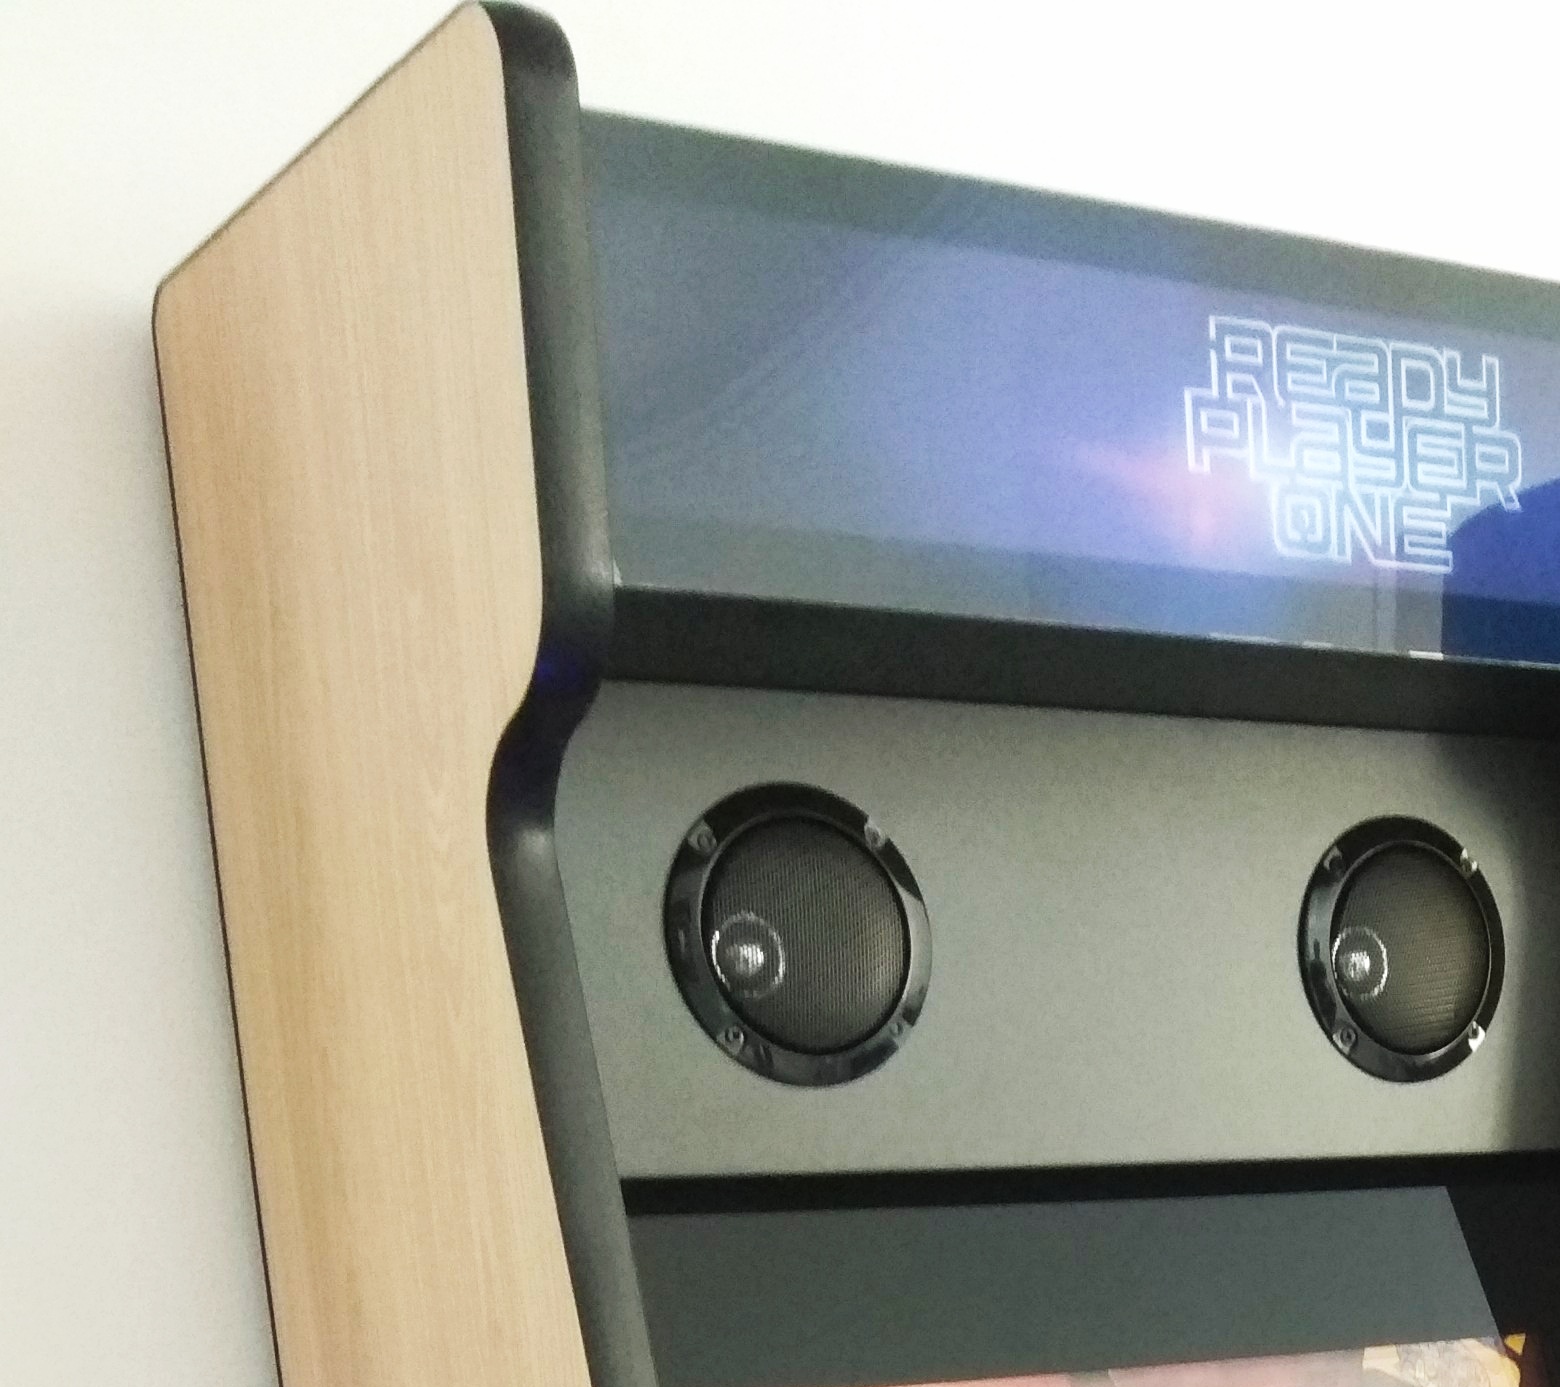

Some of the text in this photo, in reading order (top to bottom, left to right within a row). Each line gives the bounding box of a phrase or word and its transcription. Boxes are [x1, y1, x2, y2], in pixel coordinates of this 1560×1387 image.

[1209, 315, 1500, 431] READY
[1184, 388, 1523, 512] PLAYER
[1270, 484, 1453, 574] ONE
